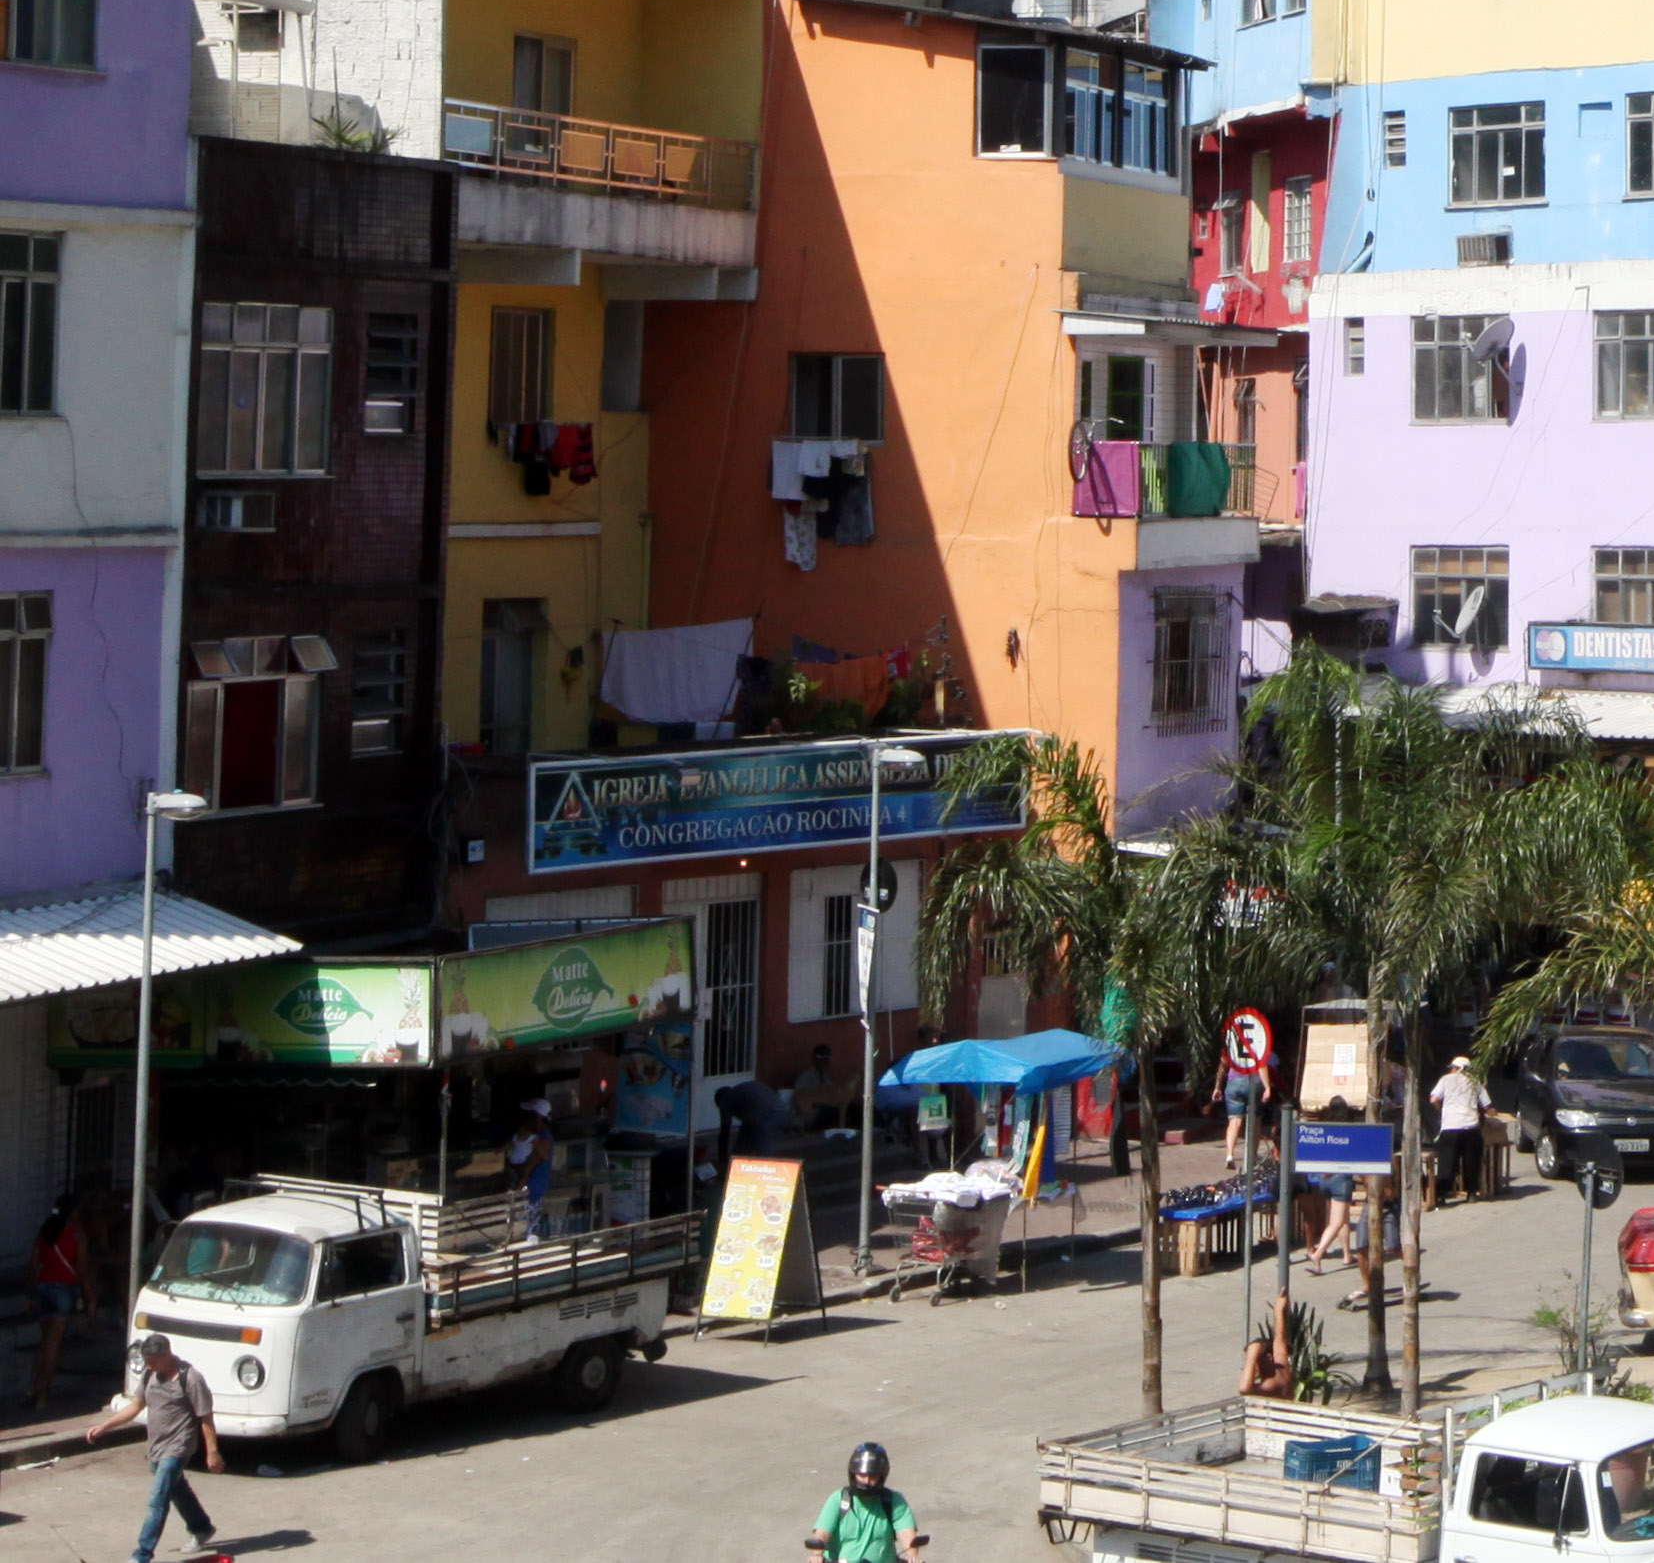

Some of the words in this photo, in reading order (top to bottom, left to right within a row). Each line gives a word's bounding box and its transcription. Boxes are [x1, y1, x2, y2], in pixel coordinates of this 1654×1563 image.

[592, 772, 671, 808] IGREJA
[797, 804, 893, 832] ROCINHA
[896, 804, 907, 823] 4
[551, 960, 589, 982] Matte
[299, 987, 343, 1002] Matte
[549, 985, 594, 1012] Delícia
[294, 1003, 348, 1023] Delícia
[1298, 1135, 1325, 1144] Ailton
[1326, 1135, 1350, 1145] Rosa
[1299, 1125, 1325, 1136] Praça
